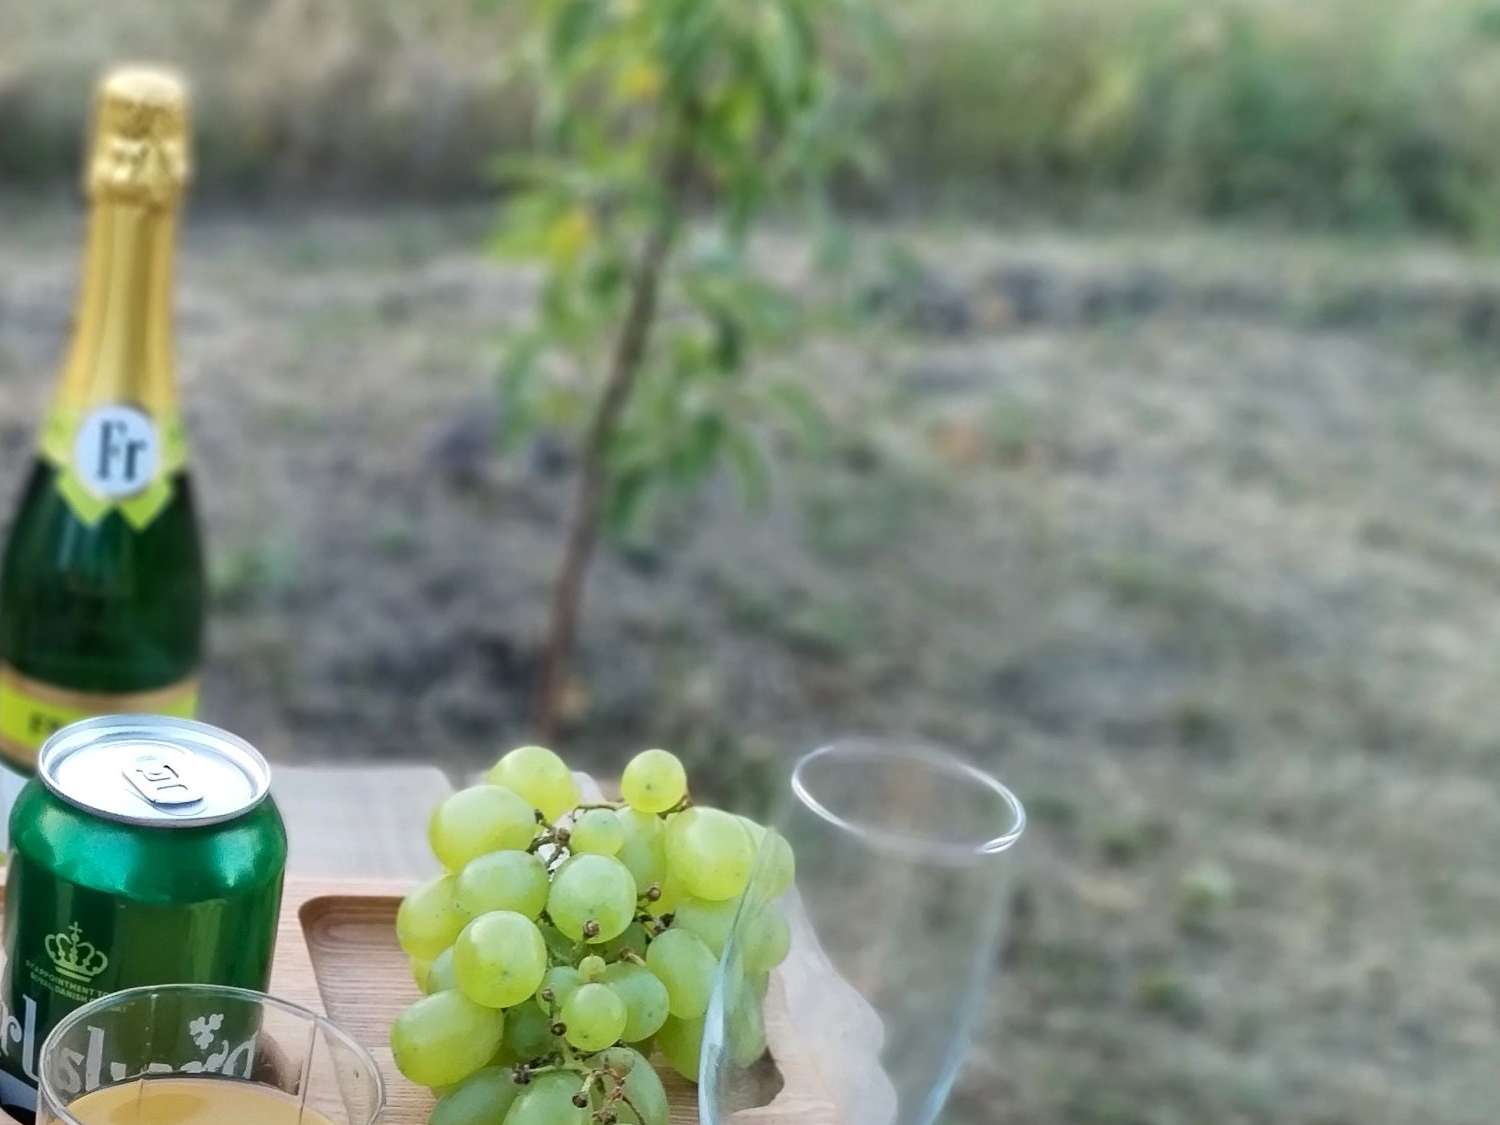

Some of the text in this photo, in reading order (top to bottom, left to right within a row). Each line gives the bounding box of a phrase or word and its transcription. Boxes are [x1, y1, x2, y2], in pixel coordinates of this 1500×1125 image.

[97, 420, 148, 482] Fr
[30, 972, 88, 1002] ROYAL DANISH
[34, 966, 95, 997] APPOINTMENT
